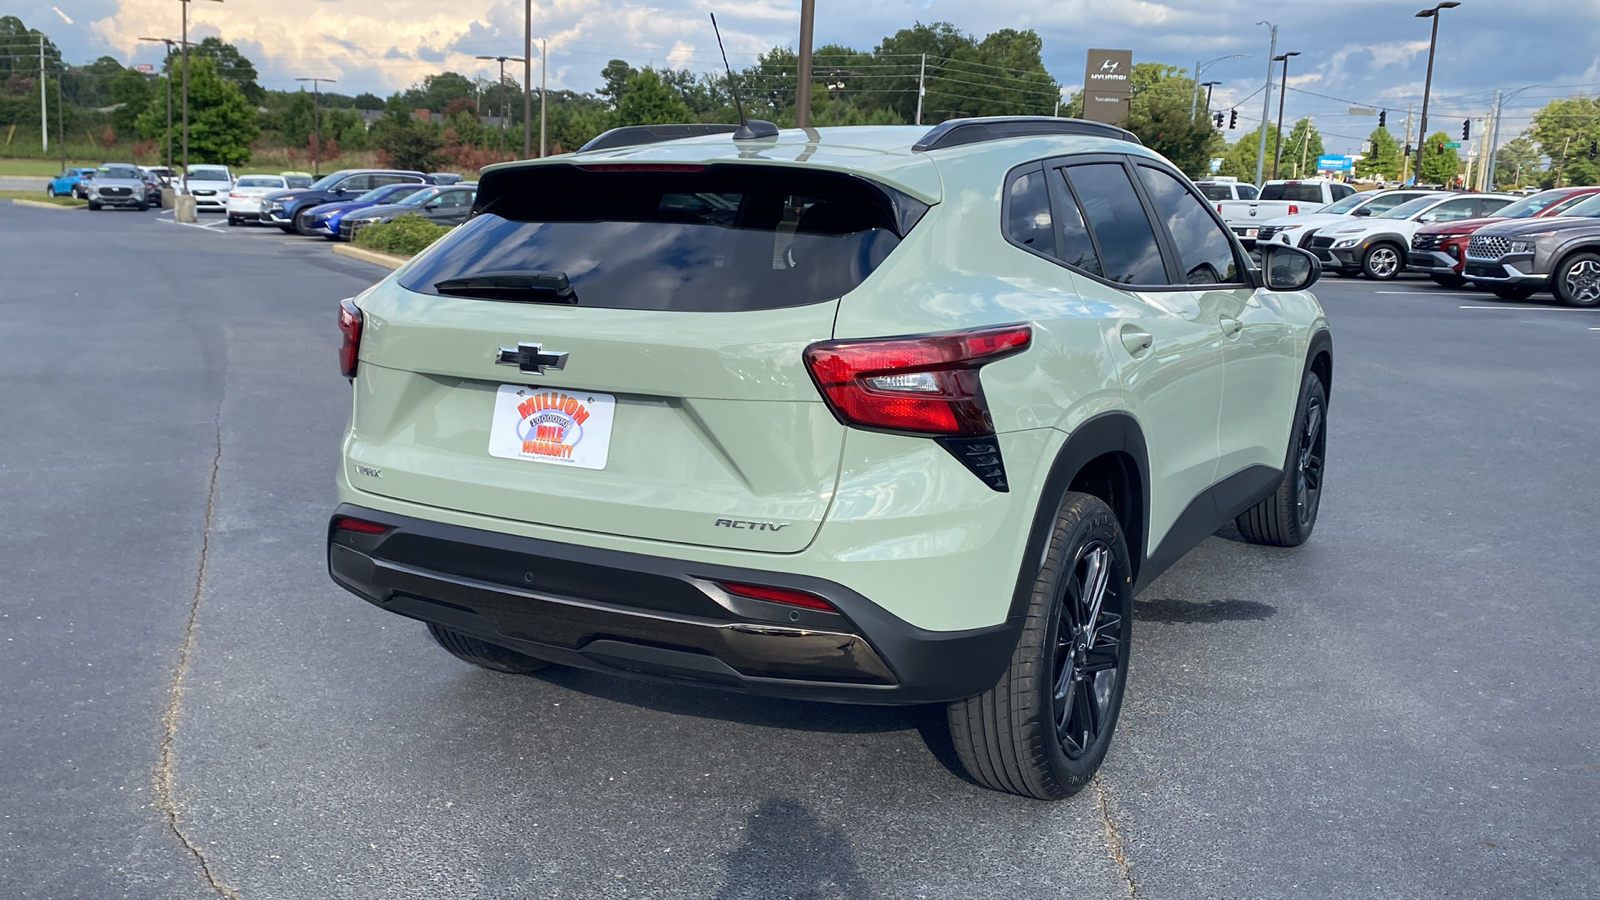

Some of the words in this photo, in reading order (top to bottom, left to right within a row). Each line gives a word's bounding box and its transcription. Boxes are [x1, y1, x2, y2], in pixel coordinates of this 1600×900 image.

[517, 392, 590, 426] MILLION
[536, 425, 564, 443] MILE
[522, 440, 574, 458] WARRANTY
[714, 518, 791, 532] ACTIV
